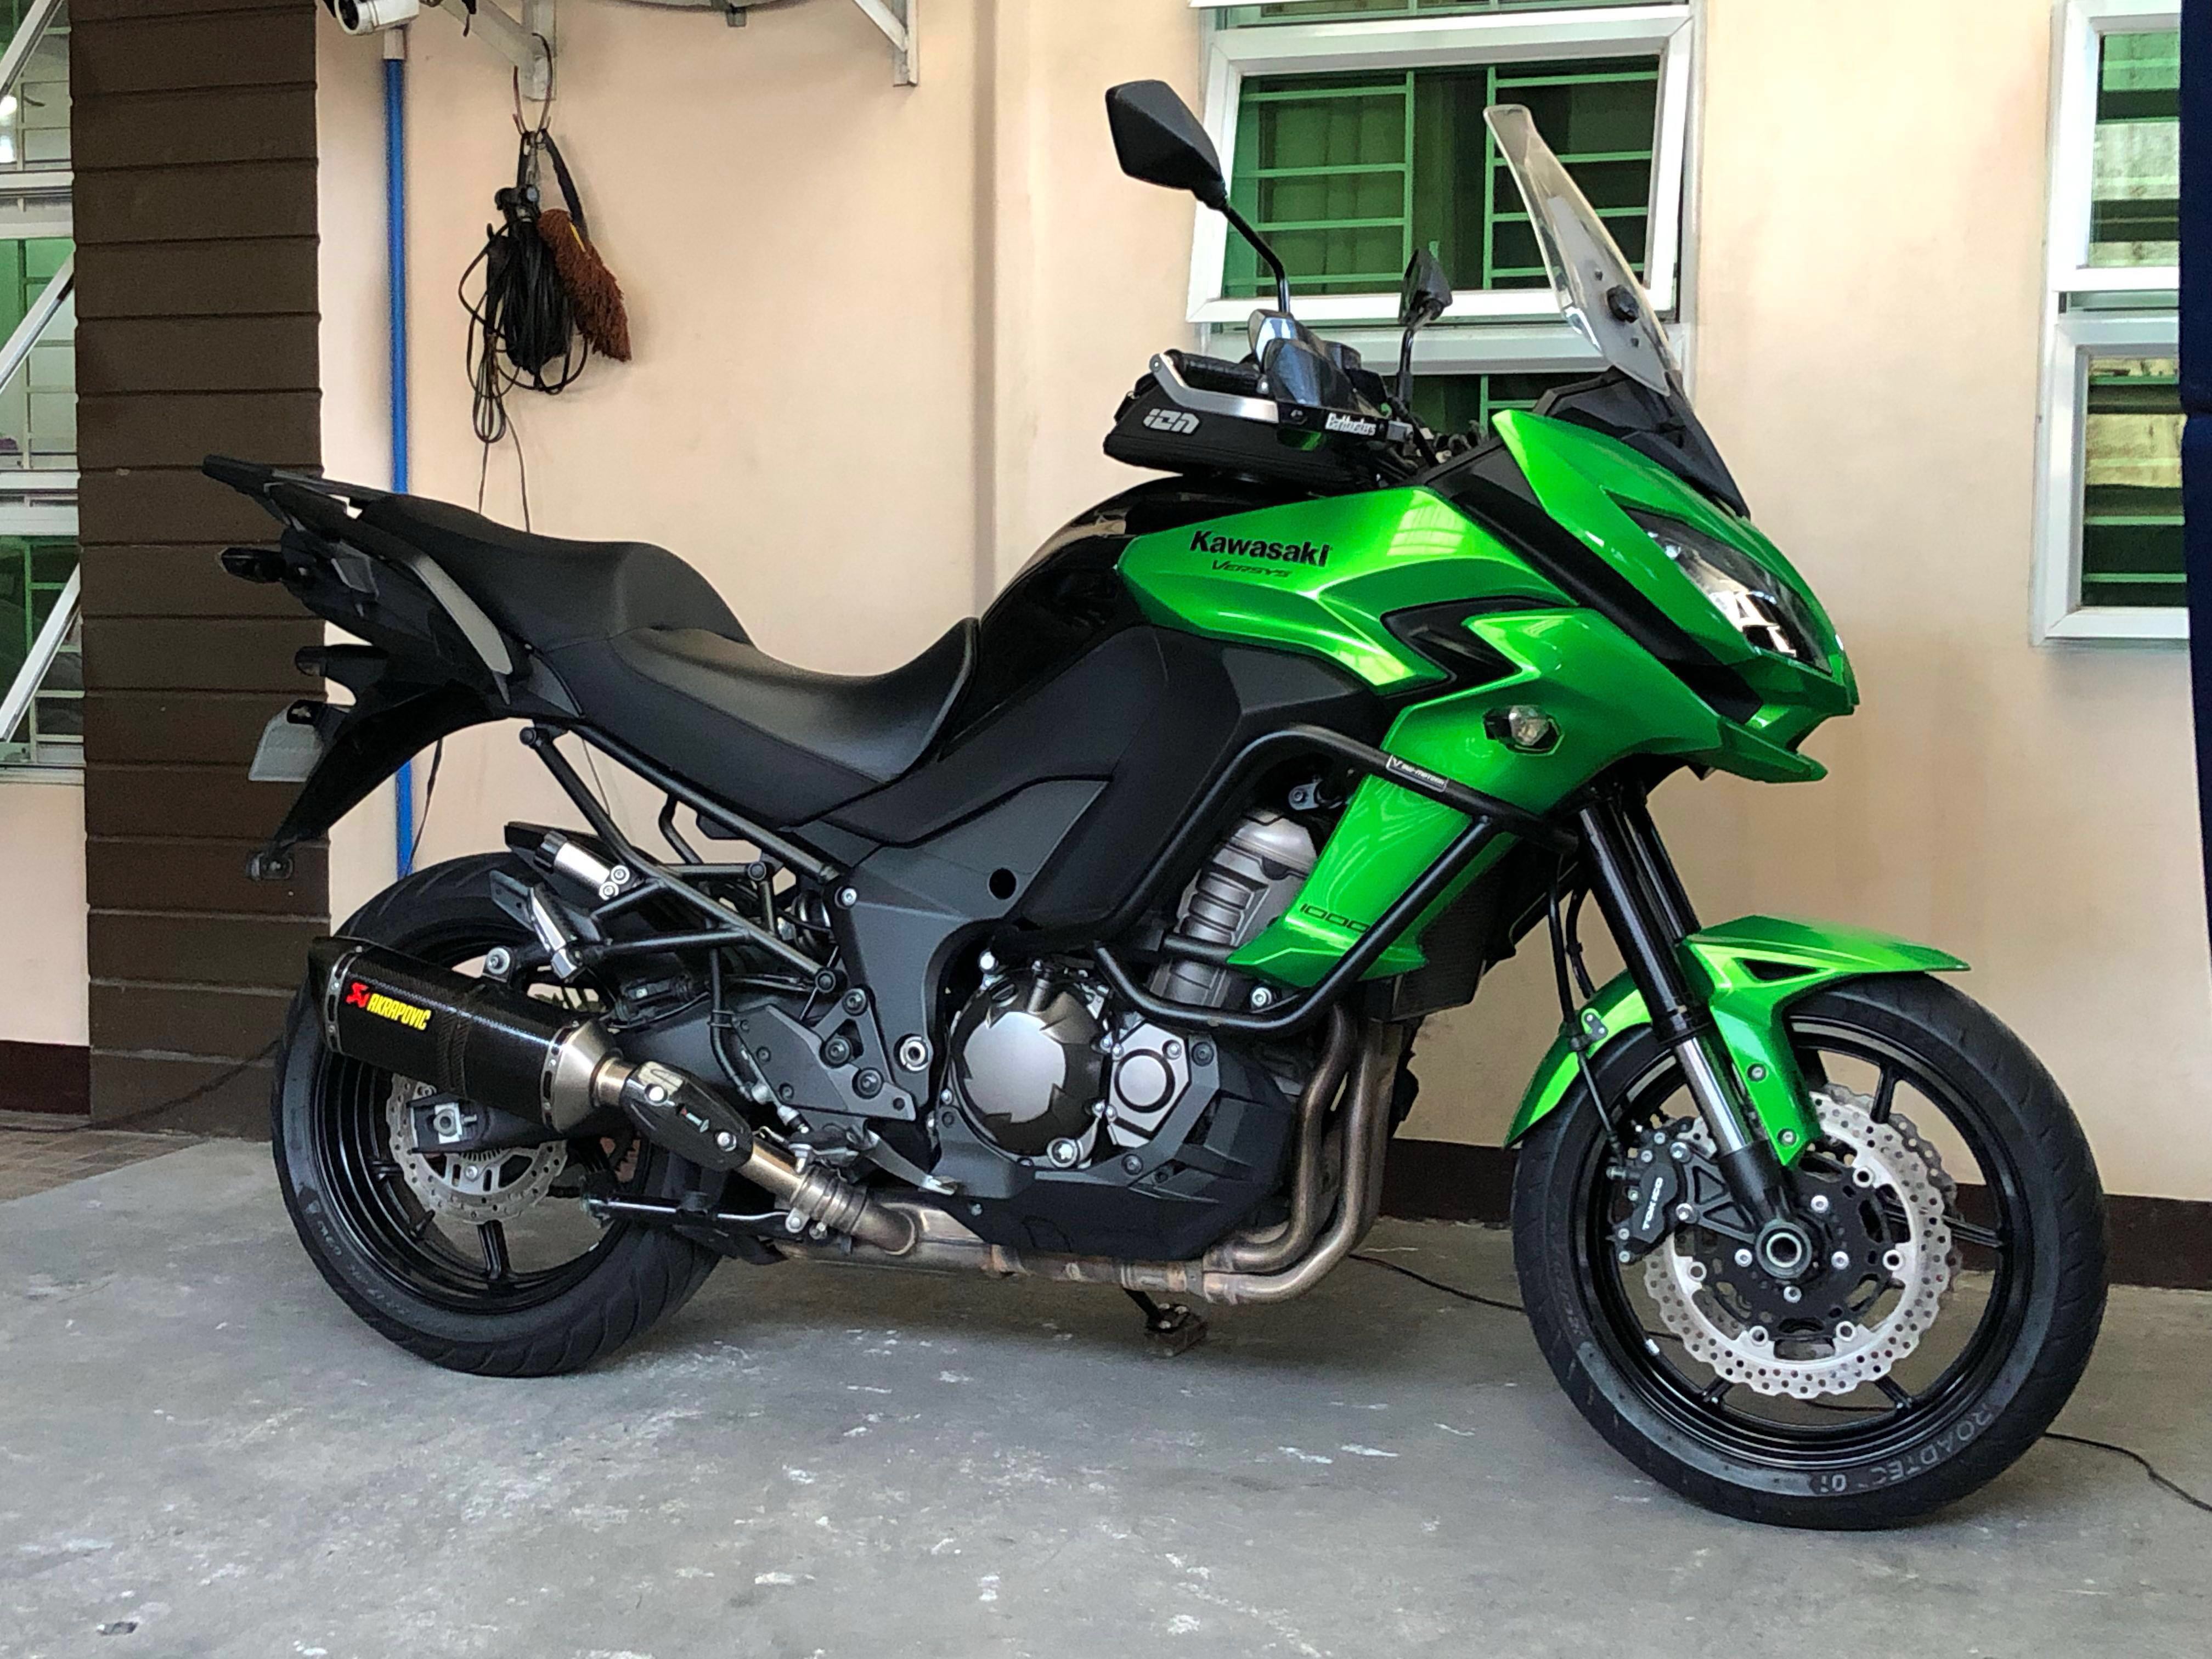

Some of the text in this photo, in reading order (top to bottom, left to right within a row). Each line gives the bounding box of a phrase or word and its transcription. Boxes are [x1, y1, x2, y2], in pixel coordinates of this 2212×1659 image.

[1189, 529, 1330, 568] Kawasaki
[1299, 903, 1370, 933] 1000
[1641, 1177, 1663, 1231] TOKICO
